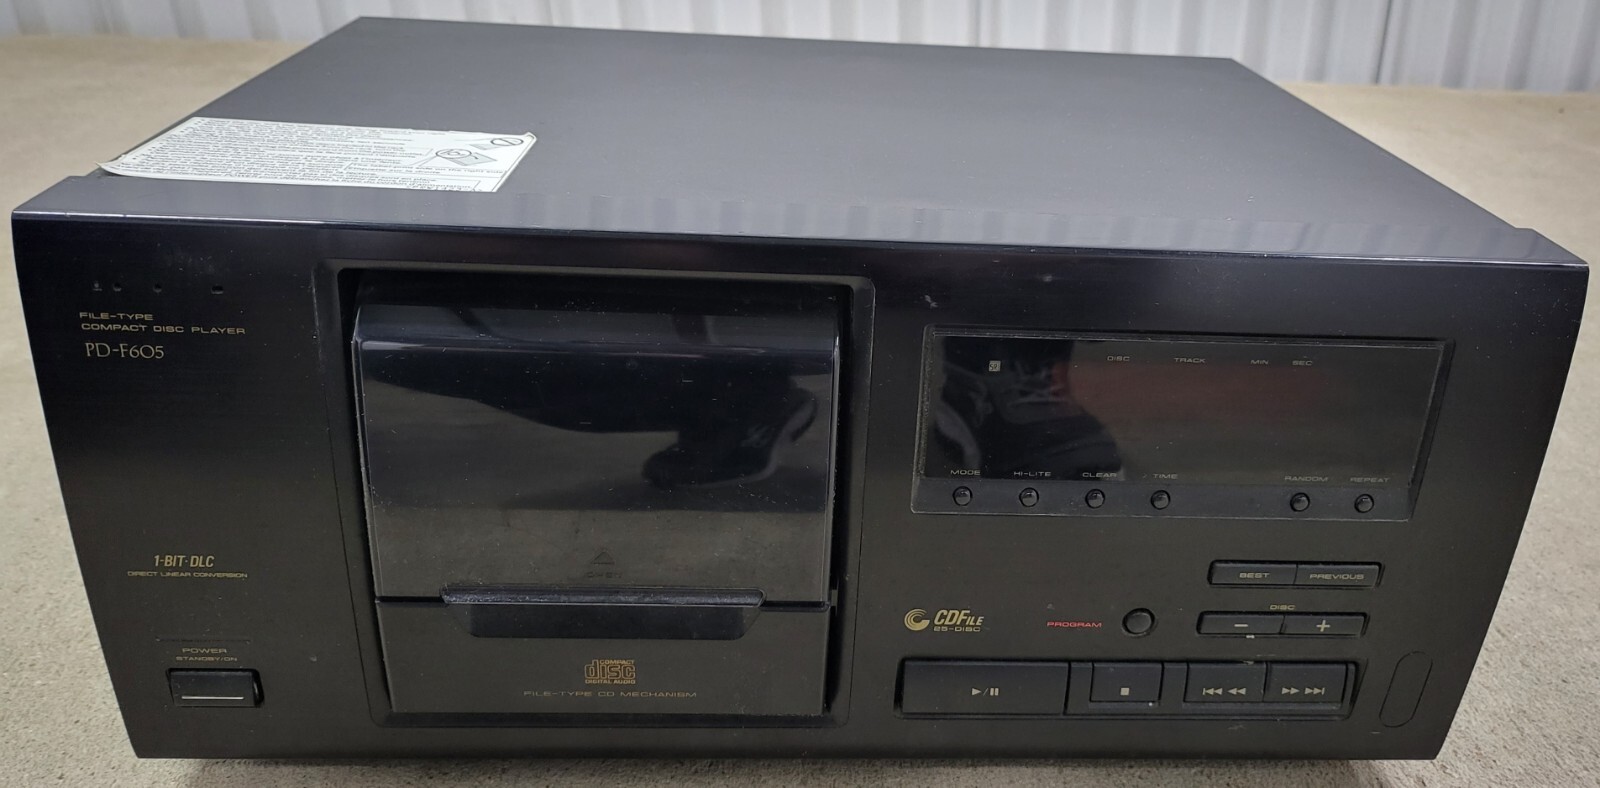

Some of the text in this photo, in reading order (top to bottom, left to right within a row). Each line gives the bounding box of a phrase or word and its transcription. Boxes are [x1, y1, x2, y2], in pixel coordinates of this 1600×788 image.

[79, 311, 154, 321] FILE-TYPE
[81, 323, 246, 335] COMPACT DISC PLAYER
[85, 342, 165, 360] PD-F605
[1107, 354, 1130, 362] DISC
[1174, 356, 1207, 364] TRACK
[950, 468, 982, 476] MODE
[1082, 471, 1118, 479] CLEAR
[193, 571, 248, 579] CONVERSION
[1046, 620, 1103, 628] PROGRAM
